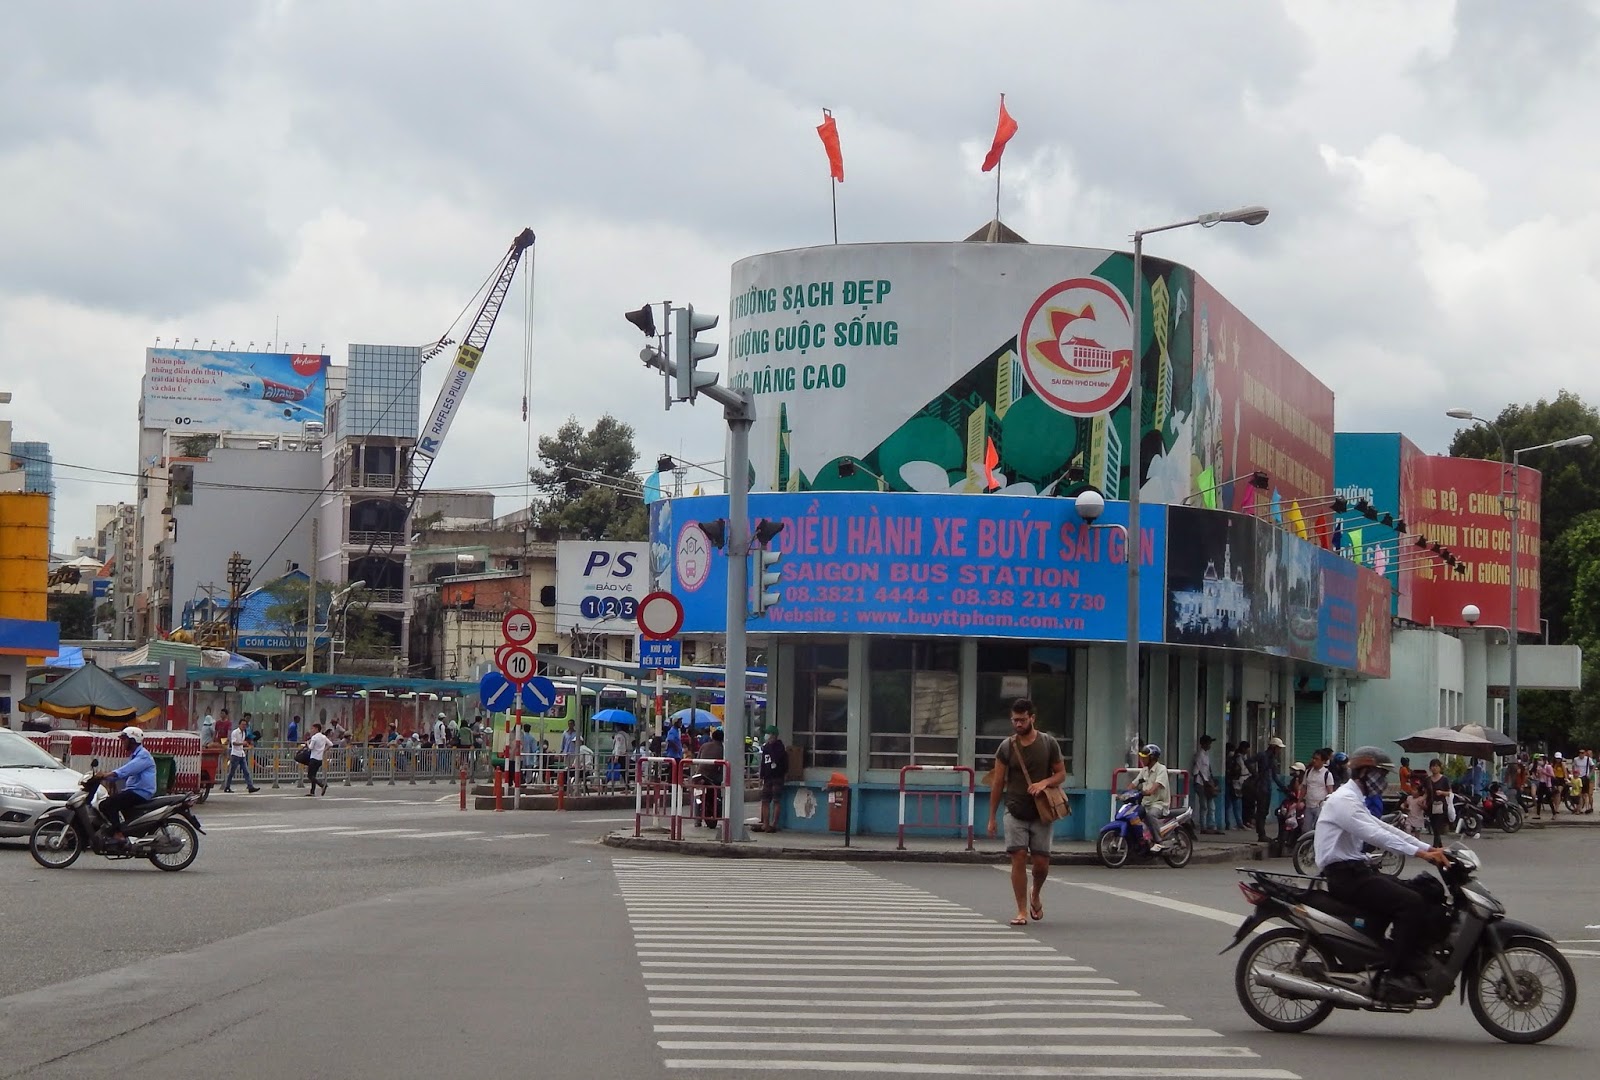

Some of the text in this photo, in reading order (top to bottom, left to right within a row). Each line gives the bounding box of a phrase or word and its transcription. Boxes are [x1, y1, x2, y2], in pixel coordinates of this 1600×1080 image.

[735, 286, 777, 319] TRƯỜNG
[782, 281, 834, 315] SẠCH
[842, 279, 892, 311] ĐẸP
[734, 329, 770, 362] LƯỢNG
[774, 319, 826, 355] CUỘC
[833, 313, 898, 347] SỐNG
[448, 370, 467, 398] PILING
[752, 365, 796, 395] NÂNG
[802, 363, 846, 390] CAO
[431, 397, 455, 435] RAFFLES
[847, 505, 922, 556] HÀNH
[932, 517, 967, 557] XE
[978, 509, 1051, 560] BUÝT
[1108, 526, 1155, 566] GN
[1462, 523, 1489, 549] TÍCH
[1491, 527, 1511, 555] CỰC
[583, 551, 637, 577] P/S
[782, 562, 1080, 588] SAIGON BUS STATION
[1478, 560, 1511, 586] GƯƠNG
[786, 586, 865, 603] 08.3821
[874, 586, 929, 604] 4444
[952, 588, 1014, 607] 08.38
[1021, 591, 1061, 608] 214
[1069, 593, 1106, 611] 730
[769, 606, 836, 624] Website
[857, 608, 1085, 631] www.buyttphcm.com.vn
[512, 656, 526, 674] 10
[654, 656, 662, 665] XE
